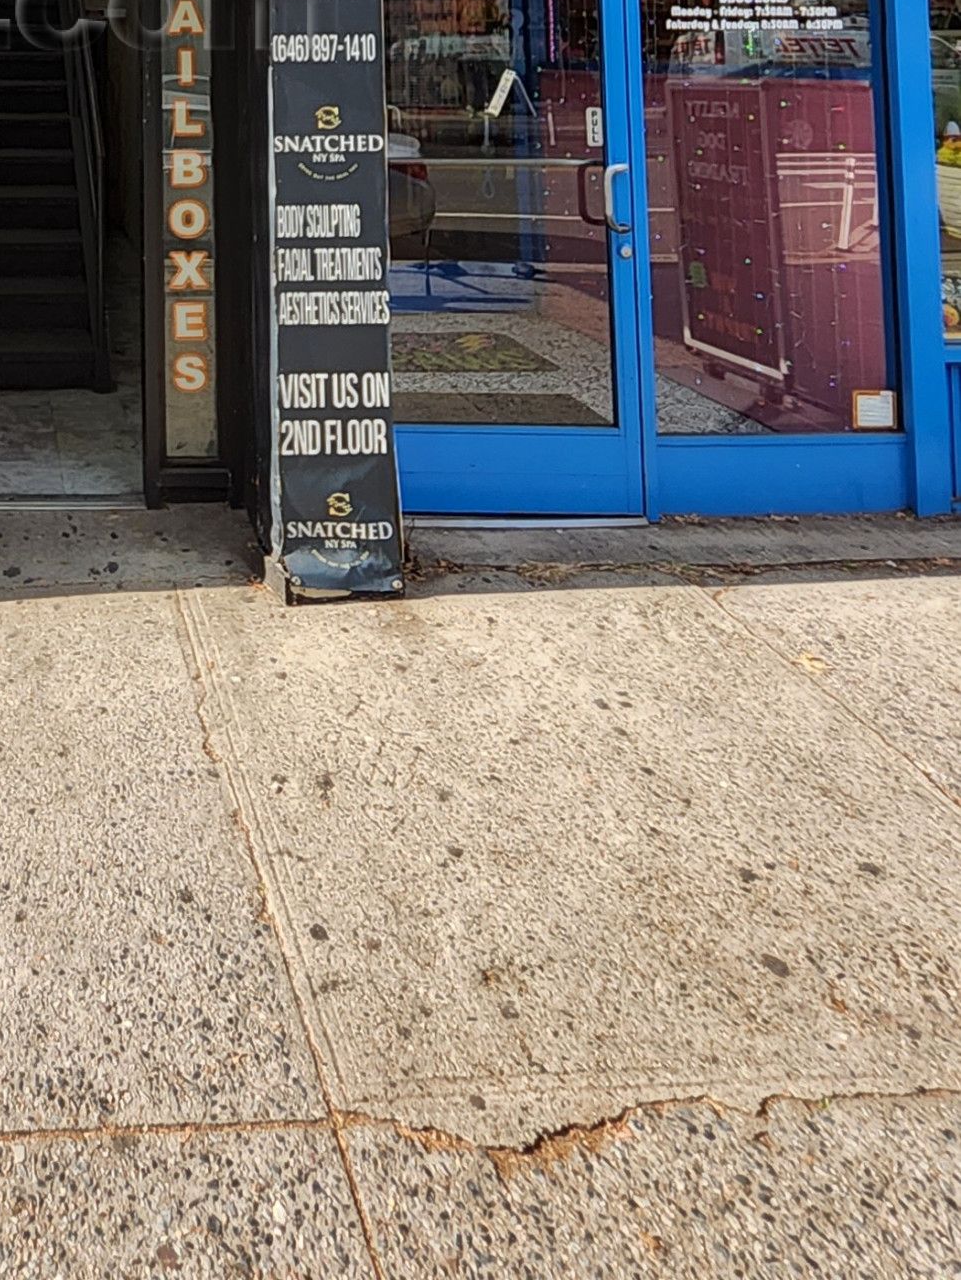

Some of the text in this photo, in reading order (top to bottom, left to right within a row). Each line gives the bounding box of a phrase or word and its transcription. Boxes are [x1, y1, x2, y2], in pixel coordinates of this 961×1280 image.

[272, 33, 376, 62] (646) 897-1410
[591, 110, 599, 143] PULL
[274, 134, 384, 153] SNATCHED
[312, 153, 346, 163] NY SPA
[277, 204, 361, 238] BODY SCULPTING
[277, 247, 382, 282] FACIAL TREATMENTS
[279, 291, 390, 325] AESTHETICS SERVICES
[279, 372, 390, 409] VISIT US ON
[280, 419, 387, 456] 2ND FLOOR
[286, 521, 393, 539] SNATCHED
[324, 540, 357, 549] NY SPA
